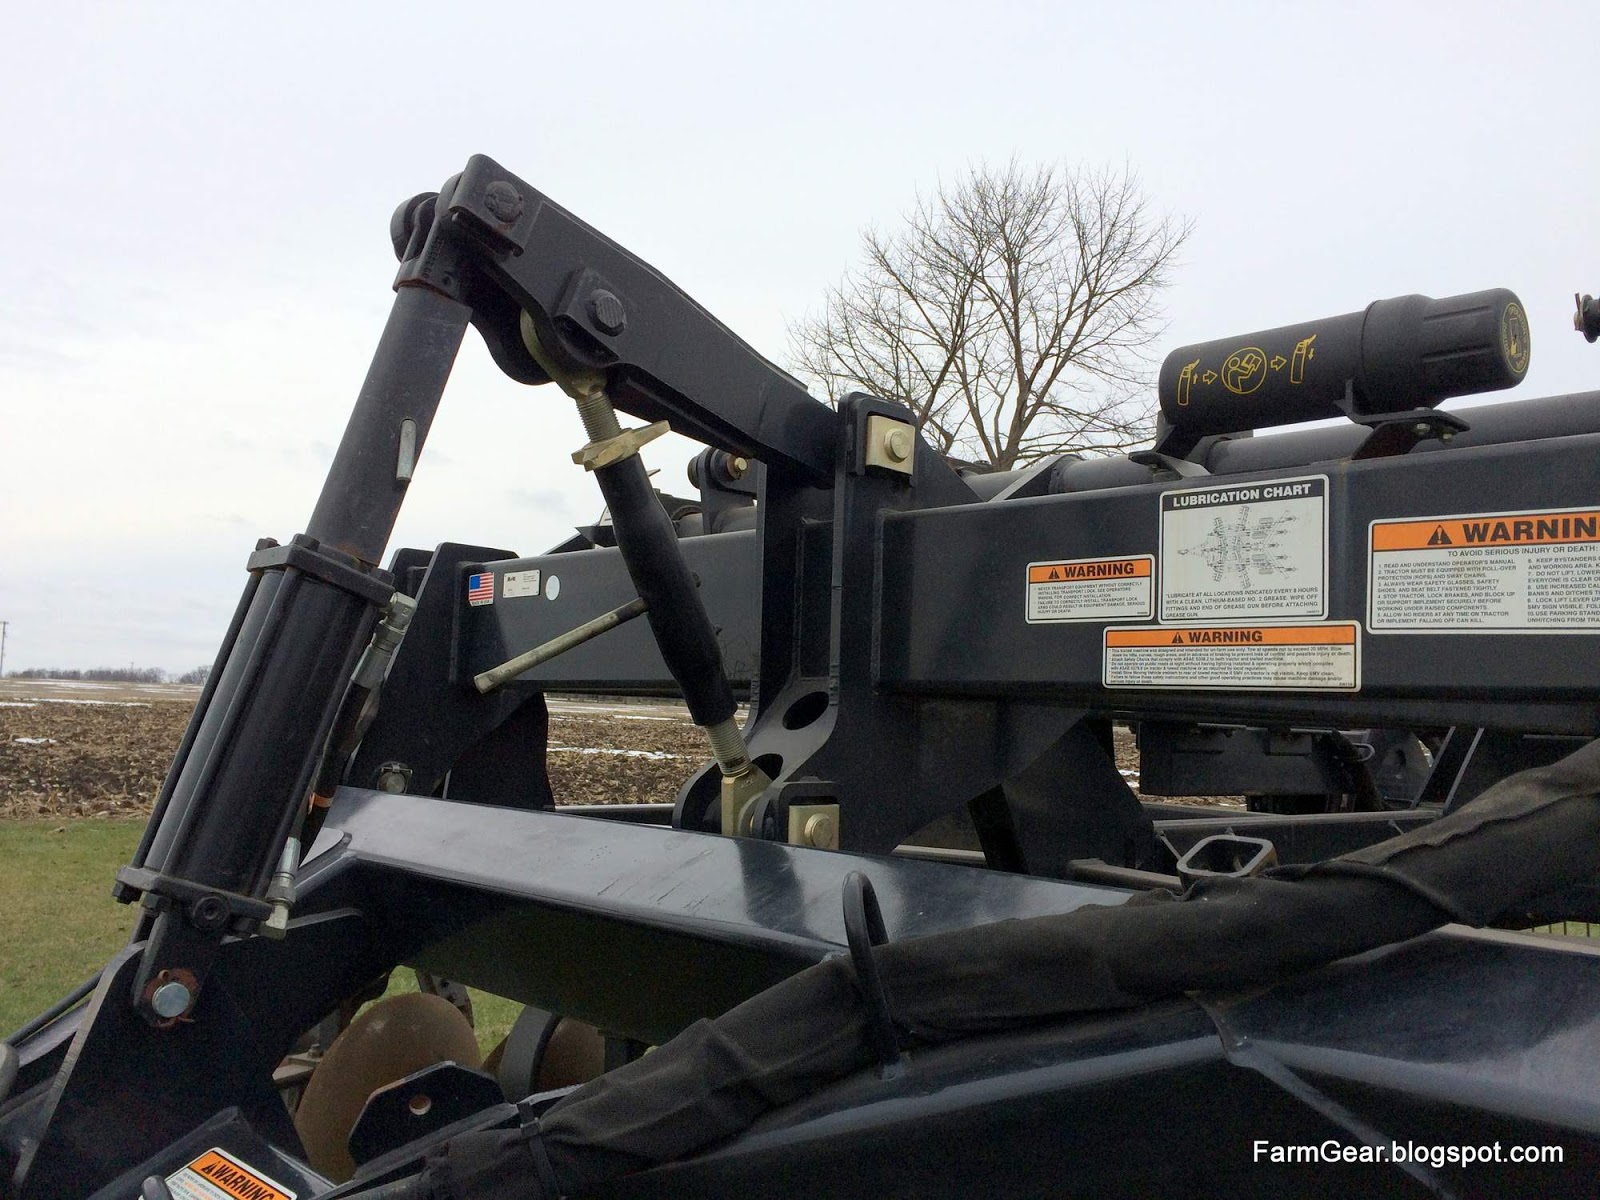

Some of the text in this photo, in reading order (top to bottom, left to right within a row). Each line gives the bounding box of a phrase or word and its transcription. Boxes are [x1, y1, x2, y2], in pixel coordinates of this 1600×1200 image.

[1173, 484, 1311, 508] LUBRICATION CHART
[1463, 517, 1600, 543] WARNIN
[1064, 563, 1134, 578] WARNING
[1188, 631, 1263, 643] WARNING
